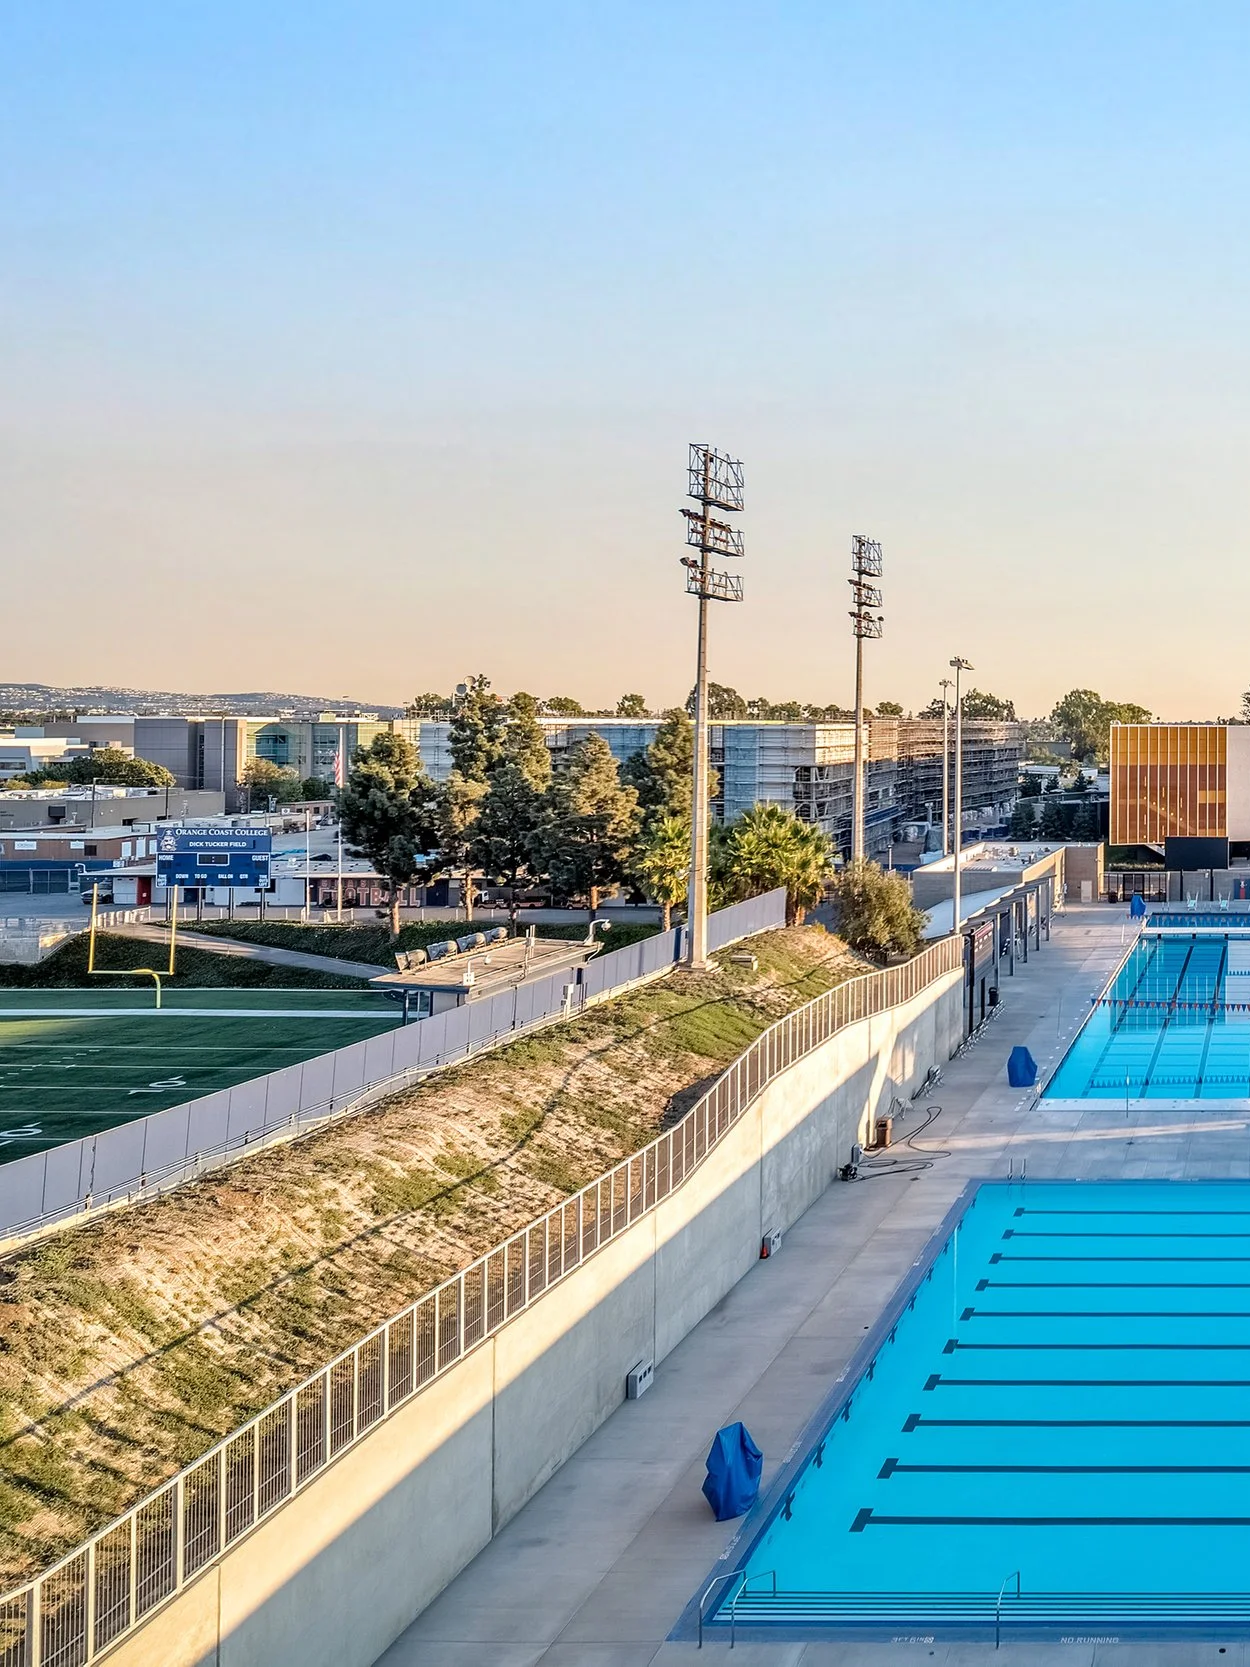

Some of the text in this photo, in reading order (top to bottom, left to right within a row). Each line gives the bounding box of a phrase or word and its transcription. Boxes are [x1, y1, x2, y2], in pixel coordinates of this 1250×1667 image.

[175, 828, 268, 836] ORANGE COAST COLLEGE
[318, 887, 420, 907] FOTBLL
